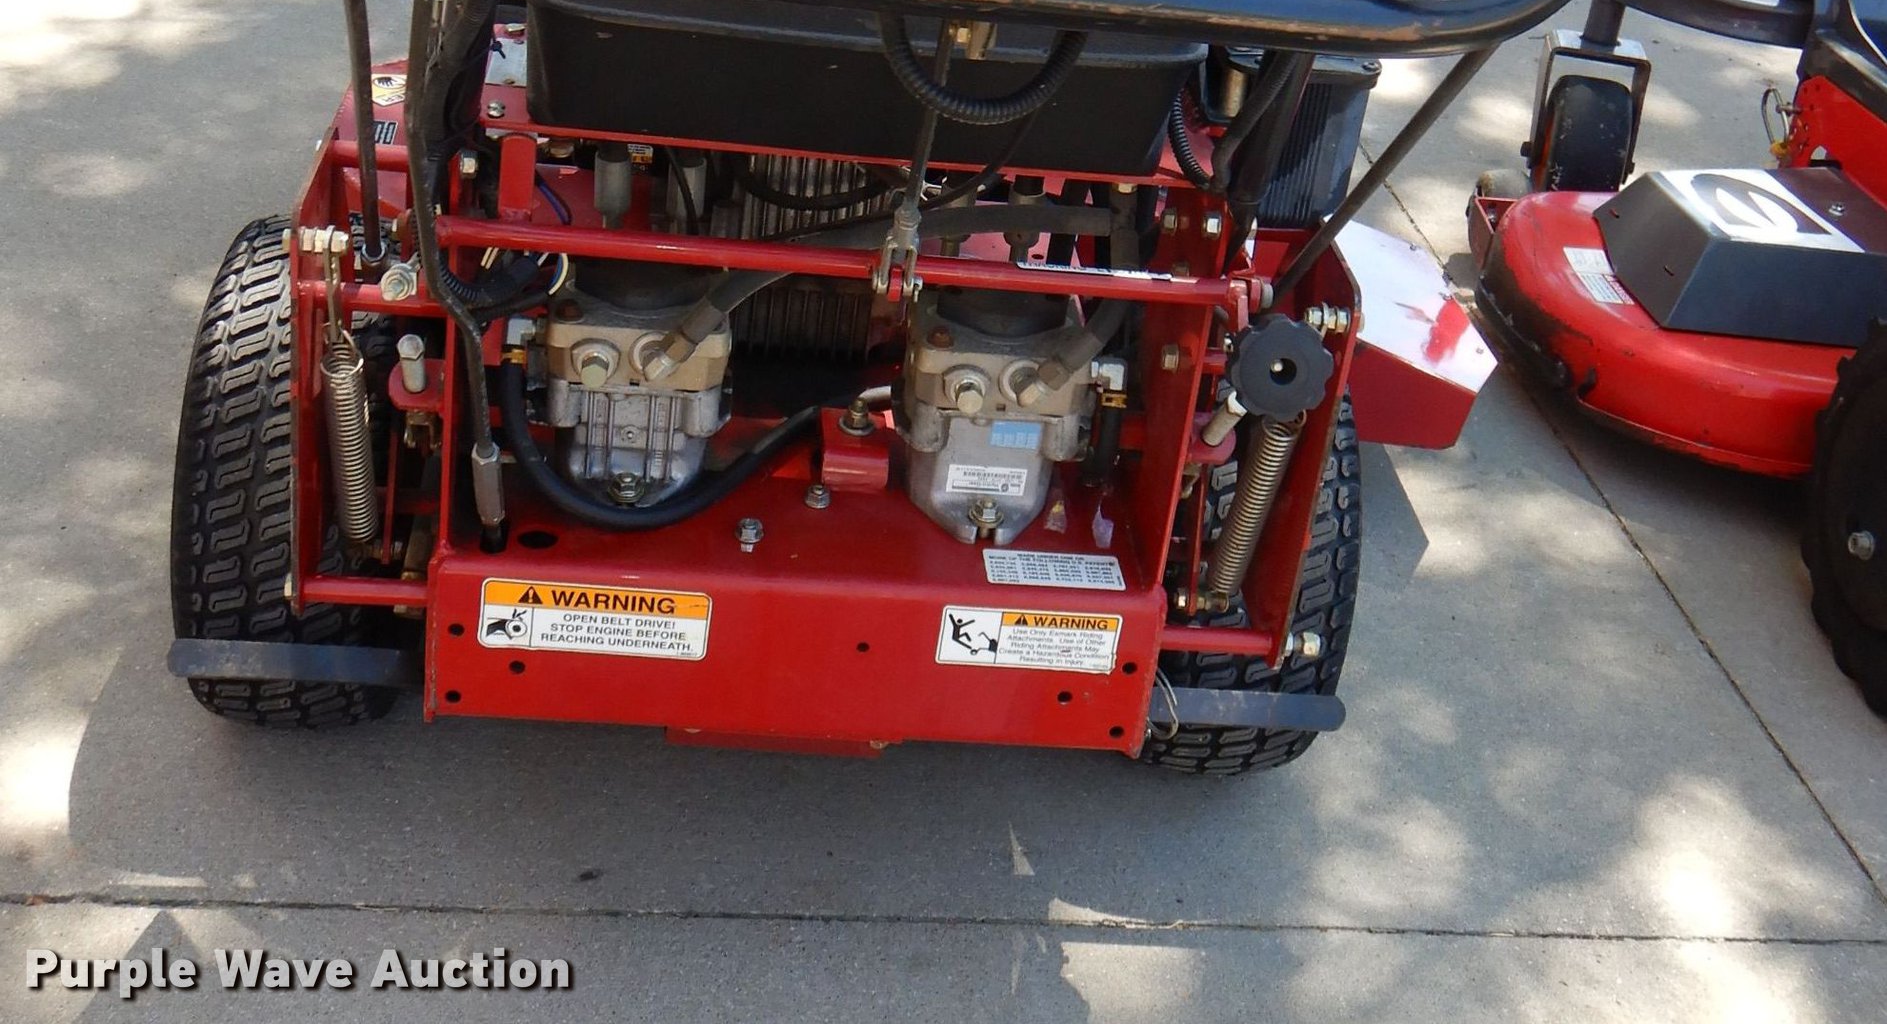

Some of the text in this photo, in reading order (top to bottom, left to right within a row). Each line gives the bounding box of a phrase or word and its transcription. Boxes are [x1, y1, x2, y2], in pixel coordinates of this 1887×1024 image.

[551, 590, 676, 614] WARNING
[563, 613, 676, 630] OPEN BELT DRIVE!
[1034, 617, 1108, 630] WARNING
[551, 623, 686, 641] STOP ENGINE BEFORE
[1029, 629, 1047, 637] Only
[541, 633, 694, 652] REACHING UNDERNEATH.
